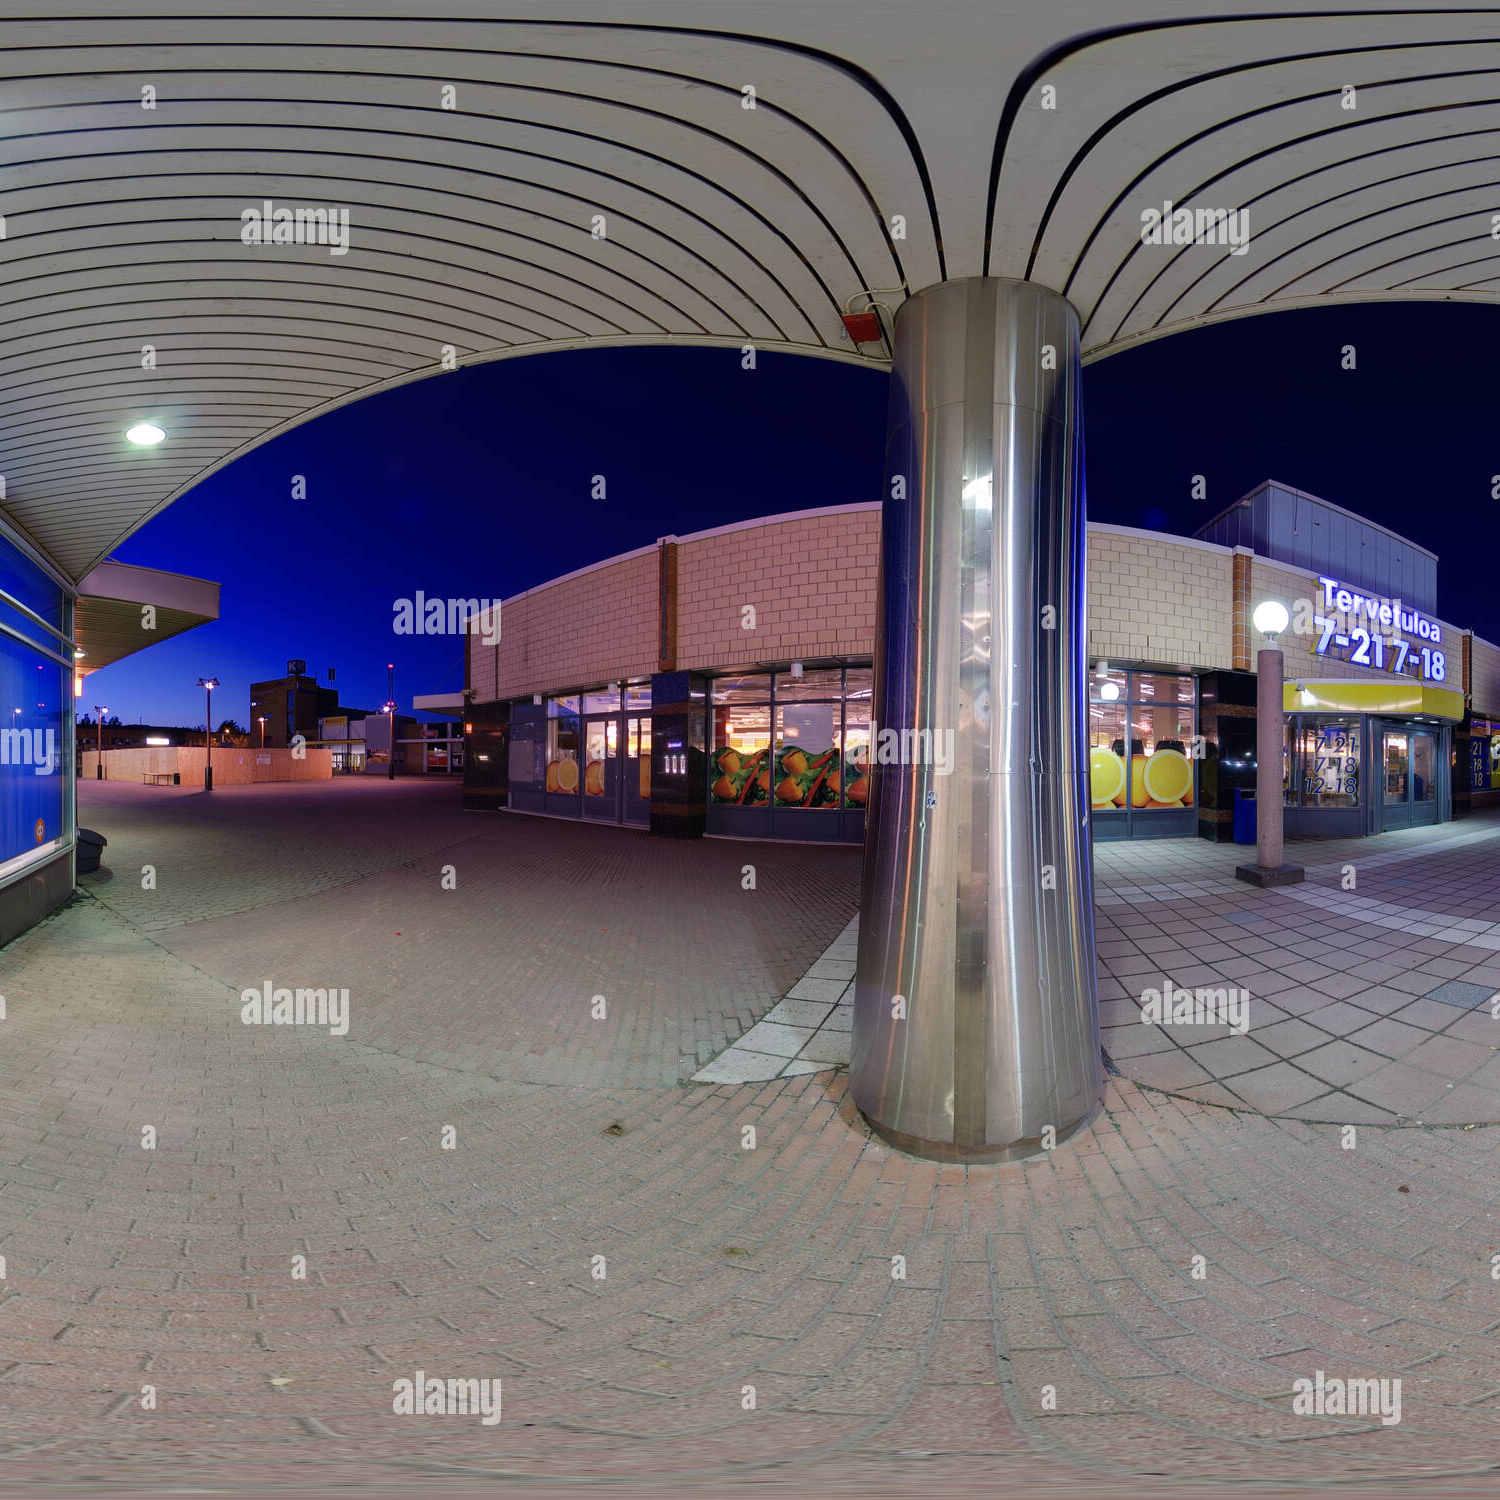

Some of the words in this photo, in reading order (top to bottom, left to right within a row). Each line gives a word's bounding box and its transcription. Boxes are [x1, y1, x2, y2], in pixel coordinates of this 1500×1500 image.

[1318, 576, 1442, 643] Tervetuloa
[1315, 736, 1356, 753] 7-21
[1315, 757, 1356, 774] 7-18
[1305, 777, 1357, 794] 12-18
